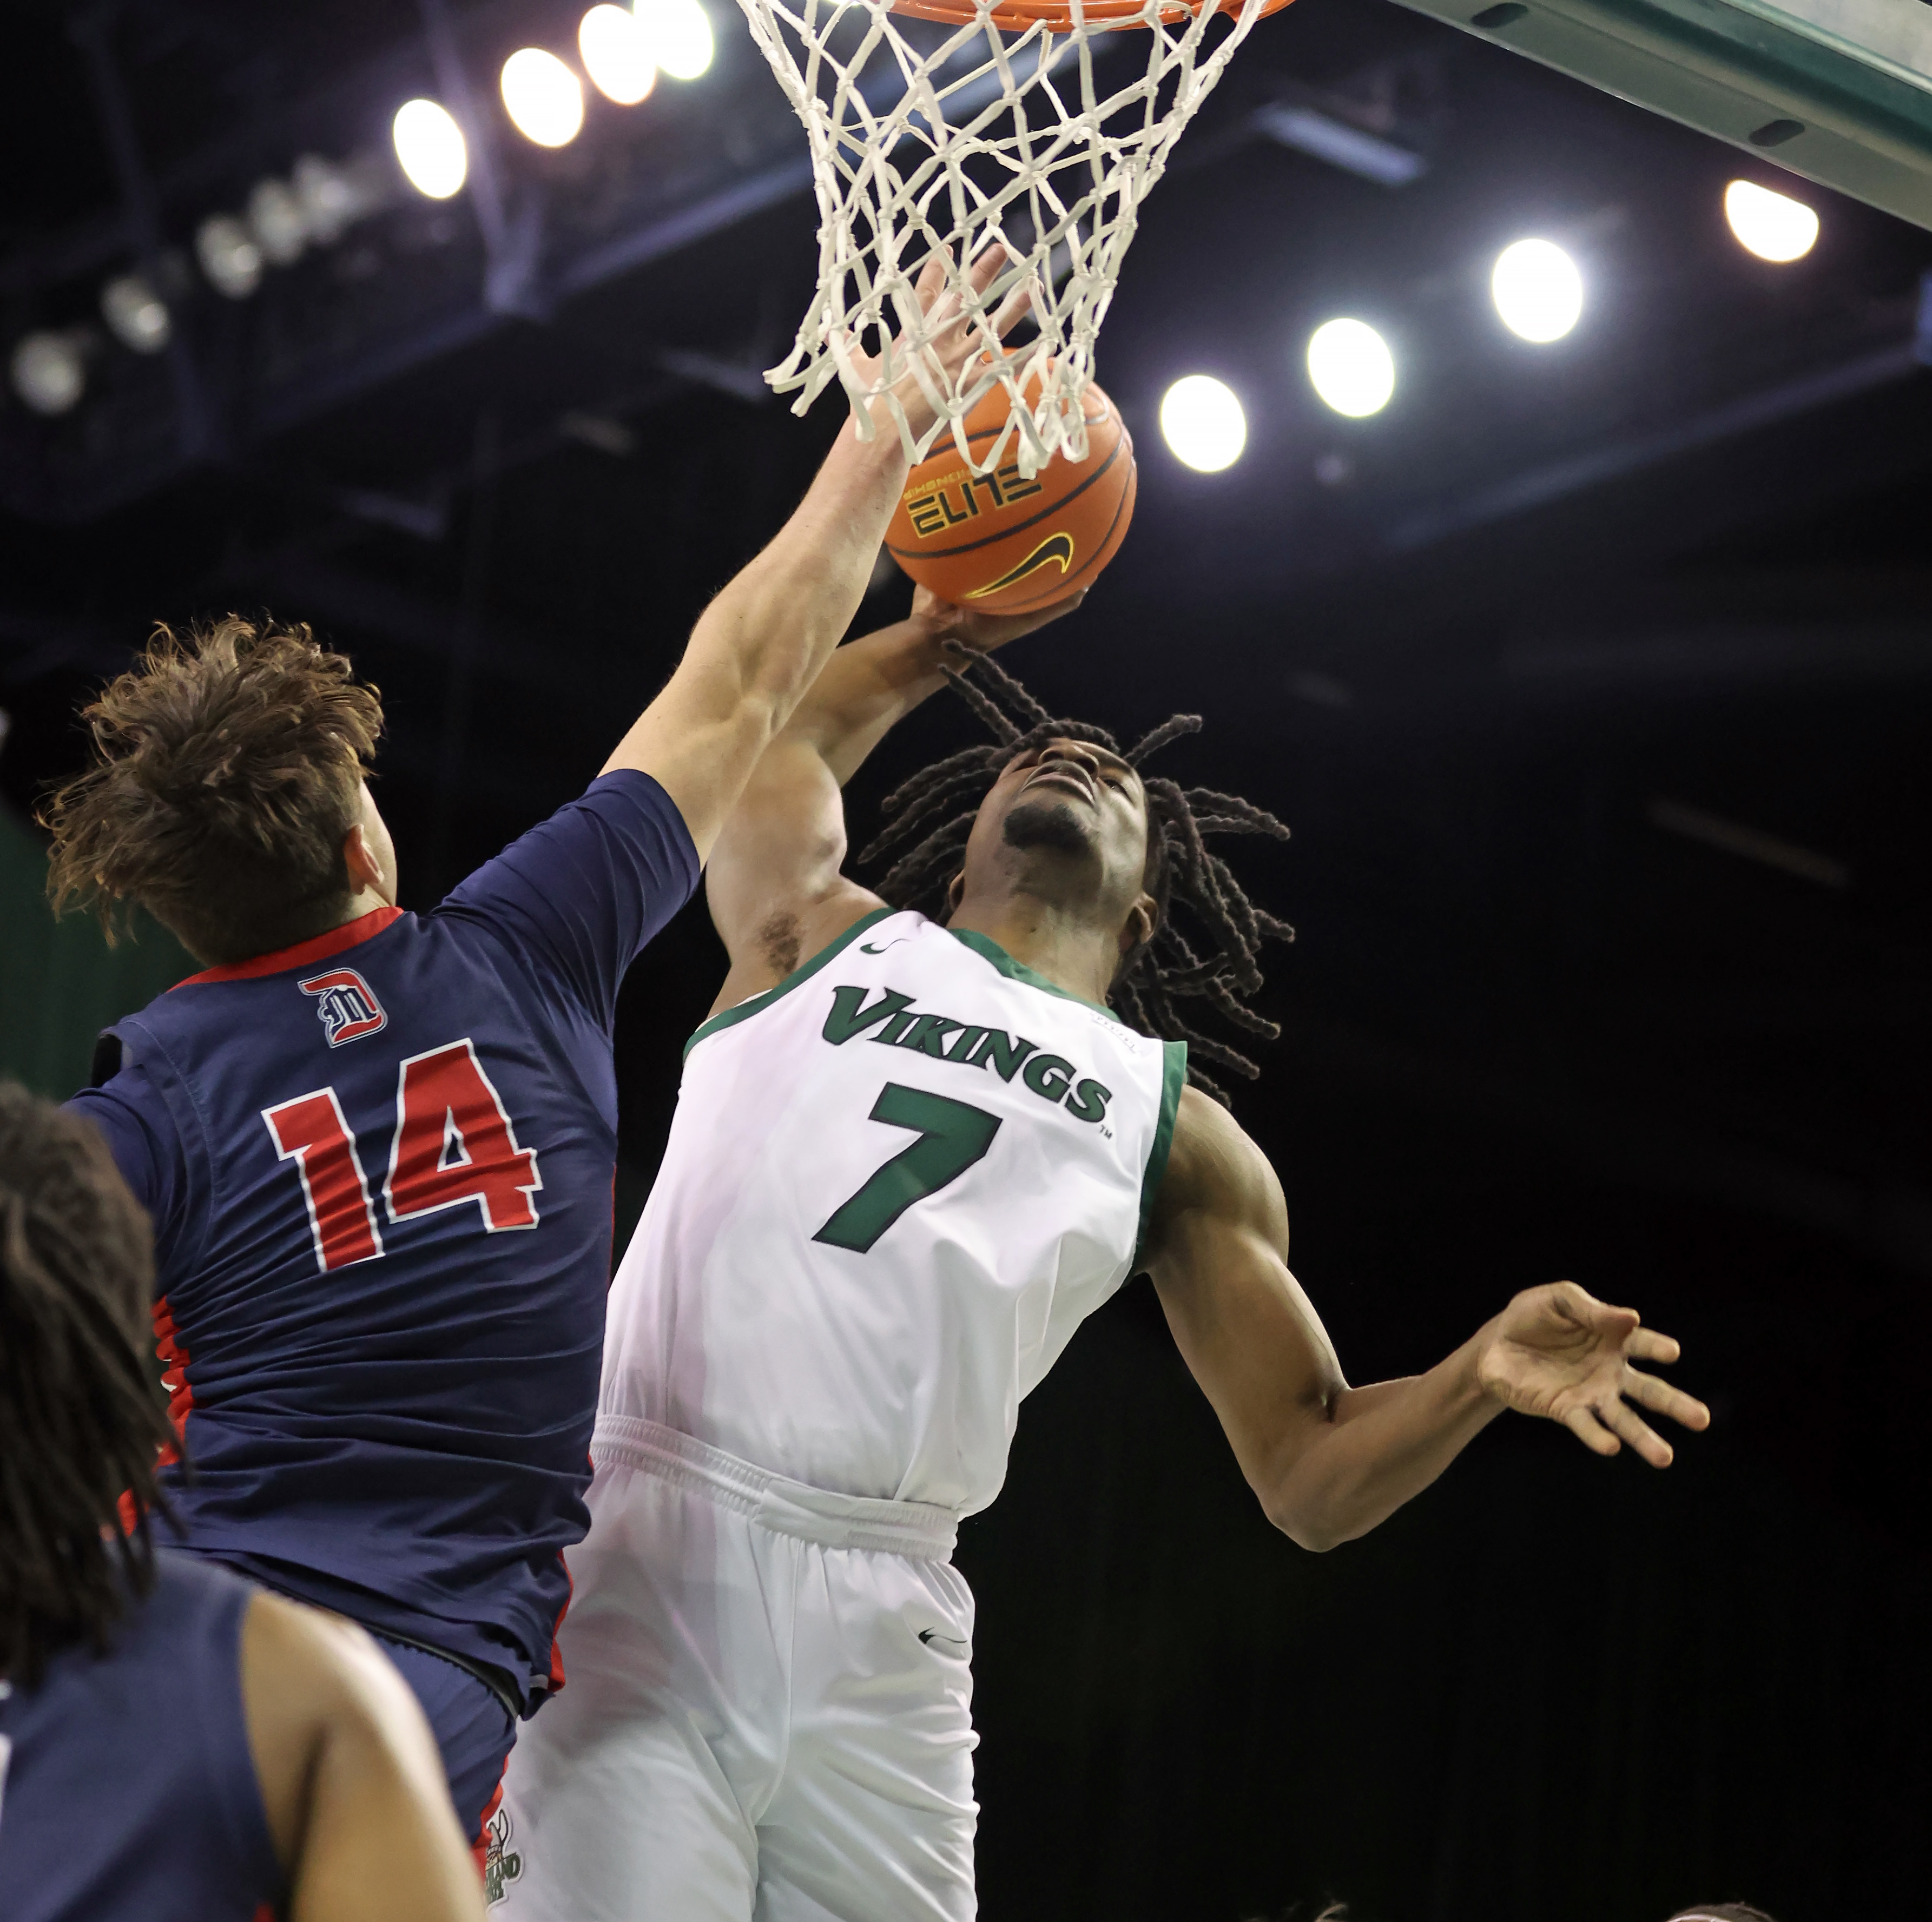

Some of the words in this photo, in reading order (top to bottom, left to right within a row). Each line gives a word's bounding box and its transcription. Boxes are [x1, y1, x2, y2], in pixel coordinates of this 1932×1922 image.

[906, 463, 1043, 539] ELITE
[822, 986, 1112, 1123] VIKINGS
[261, 1037, 544, 1273] 14
[811, 1081, 1003, 1254] 7
